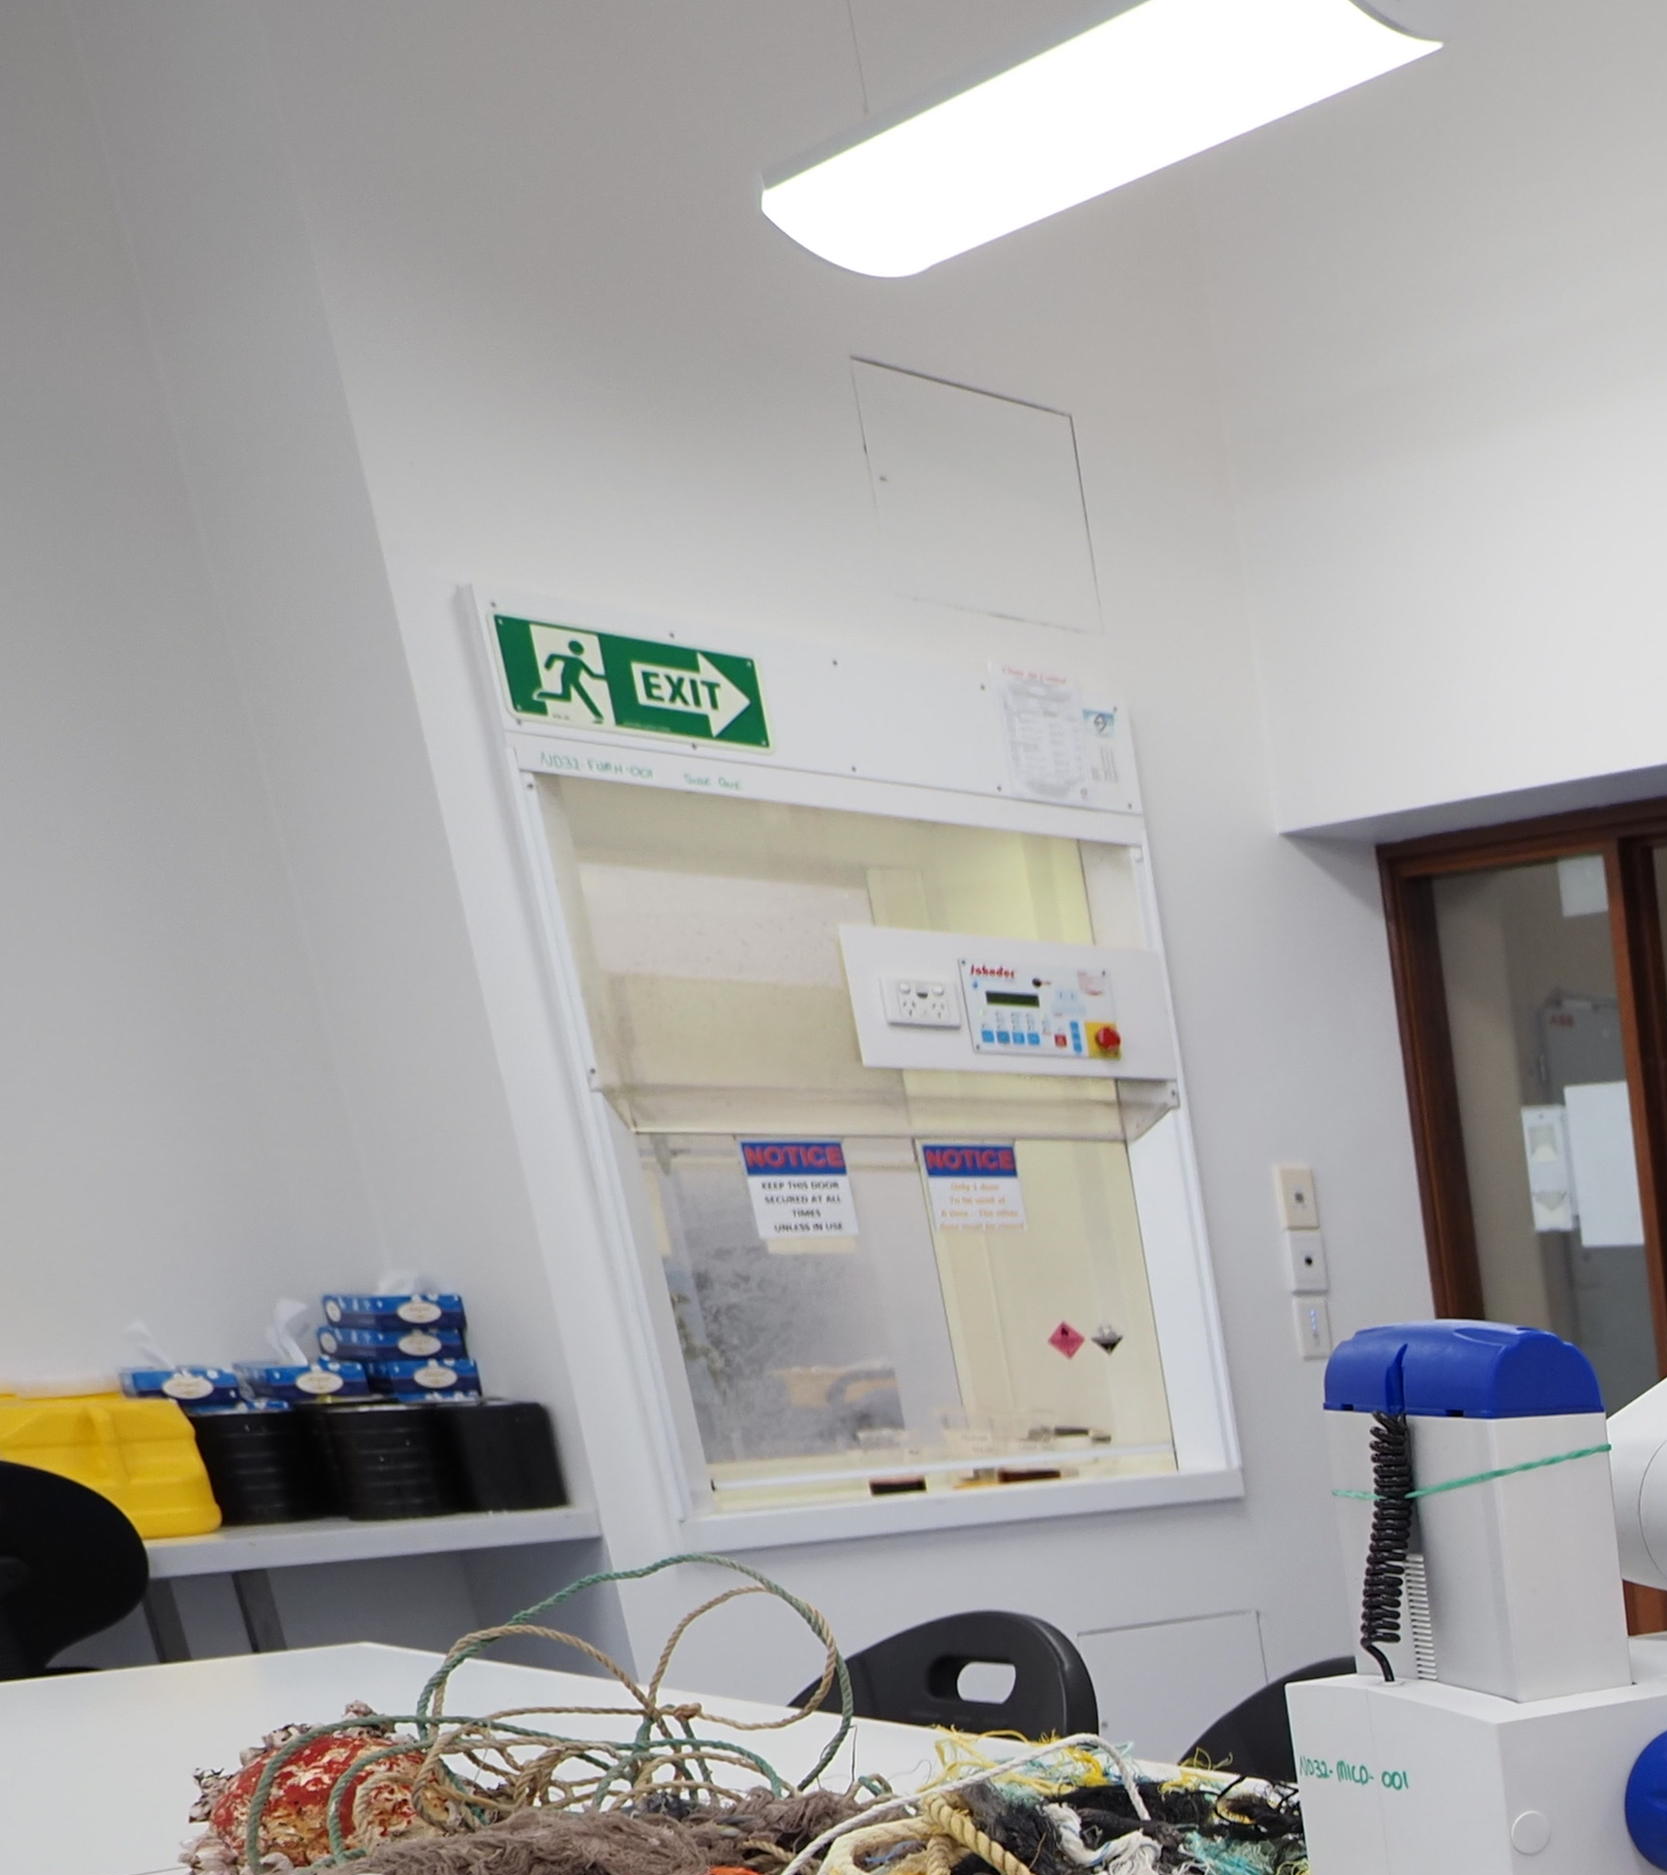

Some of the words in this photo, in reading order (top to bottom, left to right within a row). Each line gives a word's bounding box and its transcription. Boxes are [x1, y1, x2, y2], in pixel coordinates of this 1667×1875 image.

[641, 670, 721, 711] EXIT
[744, 1146, 846, 1168] NOTICE
[926, 1149, 1014, 1171] NOTICE
[787, 1181, 808, 1189] THIS
[811, 1181, 839, 1189] DOOR
[811, 1195, 823, 1203] AT
[792, 1209, 821, 1217] TIMES
